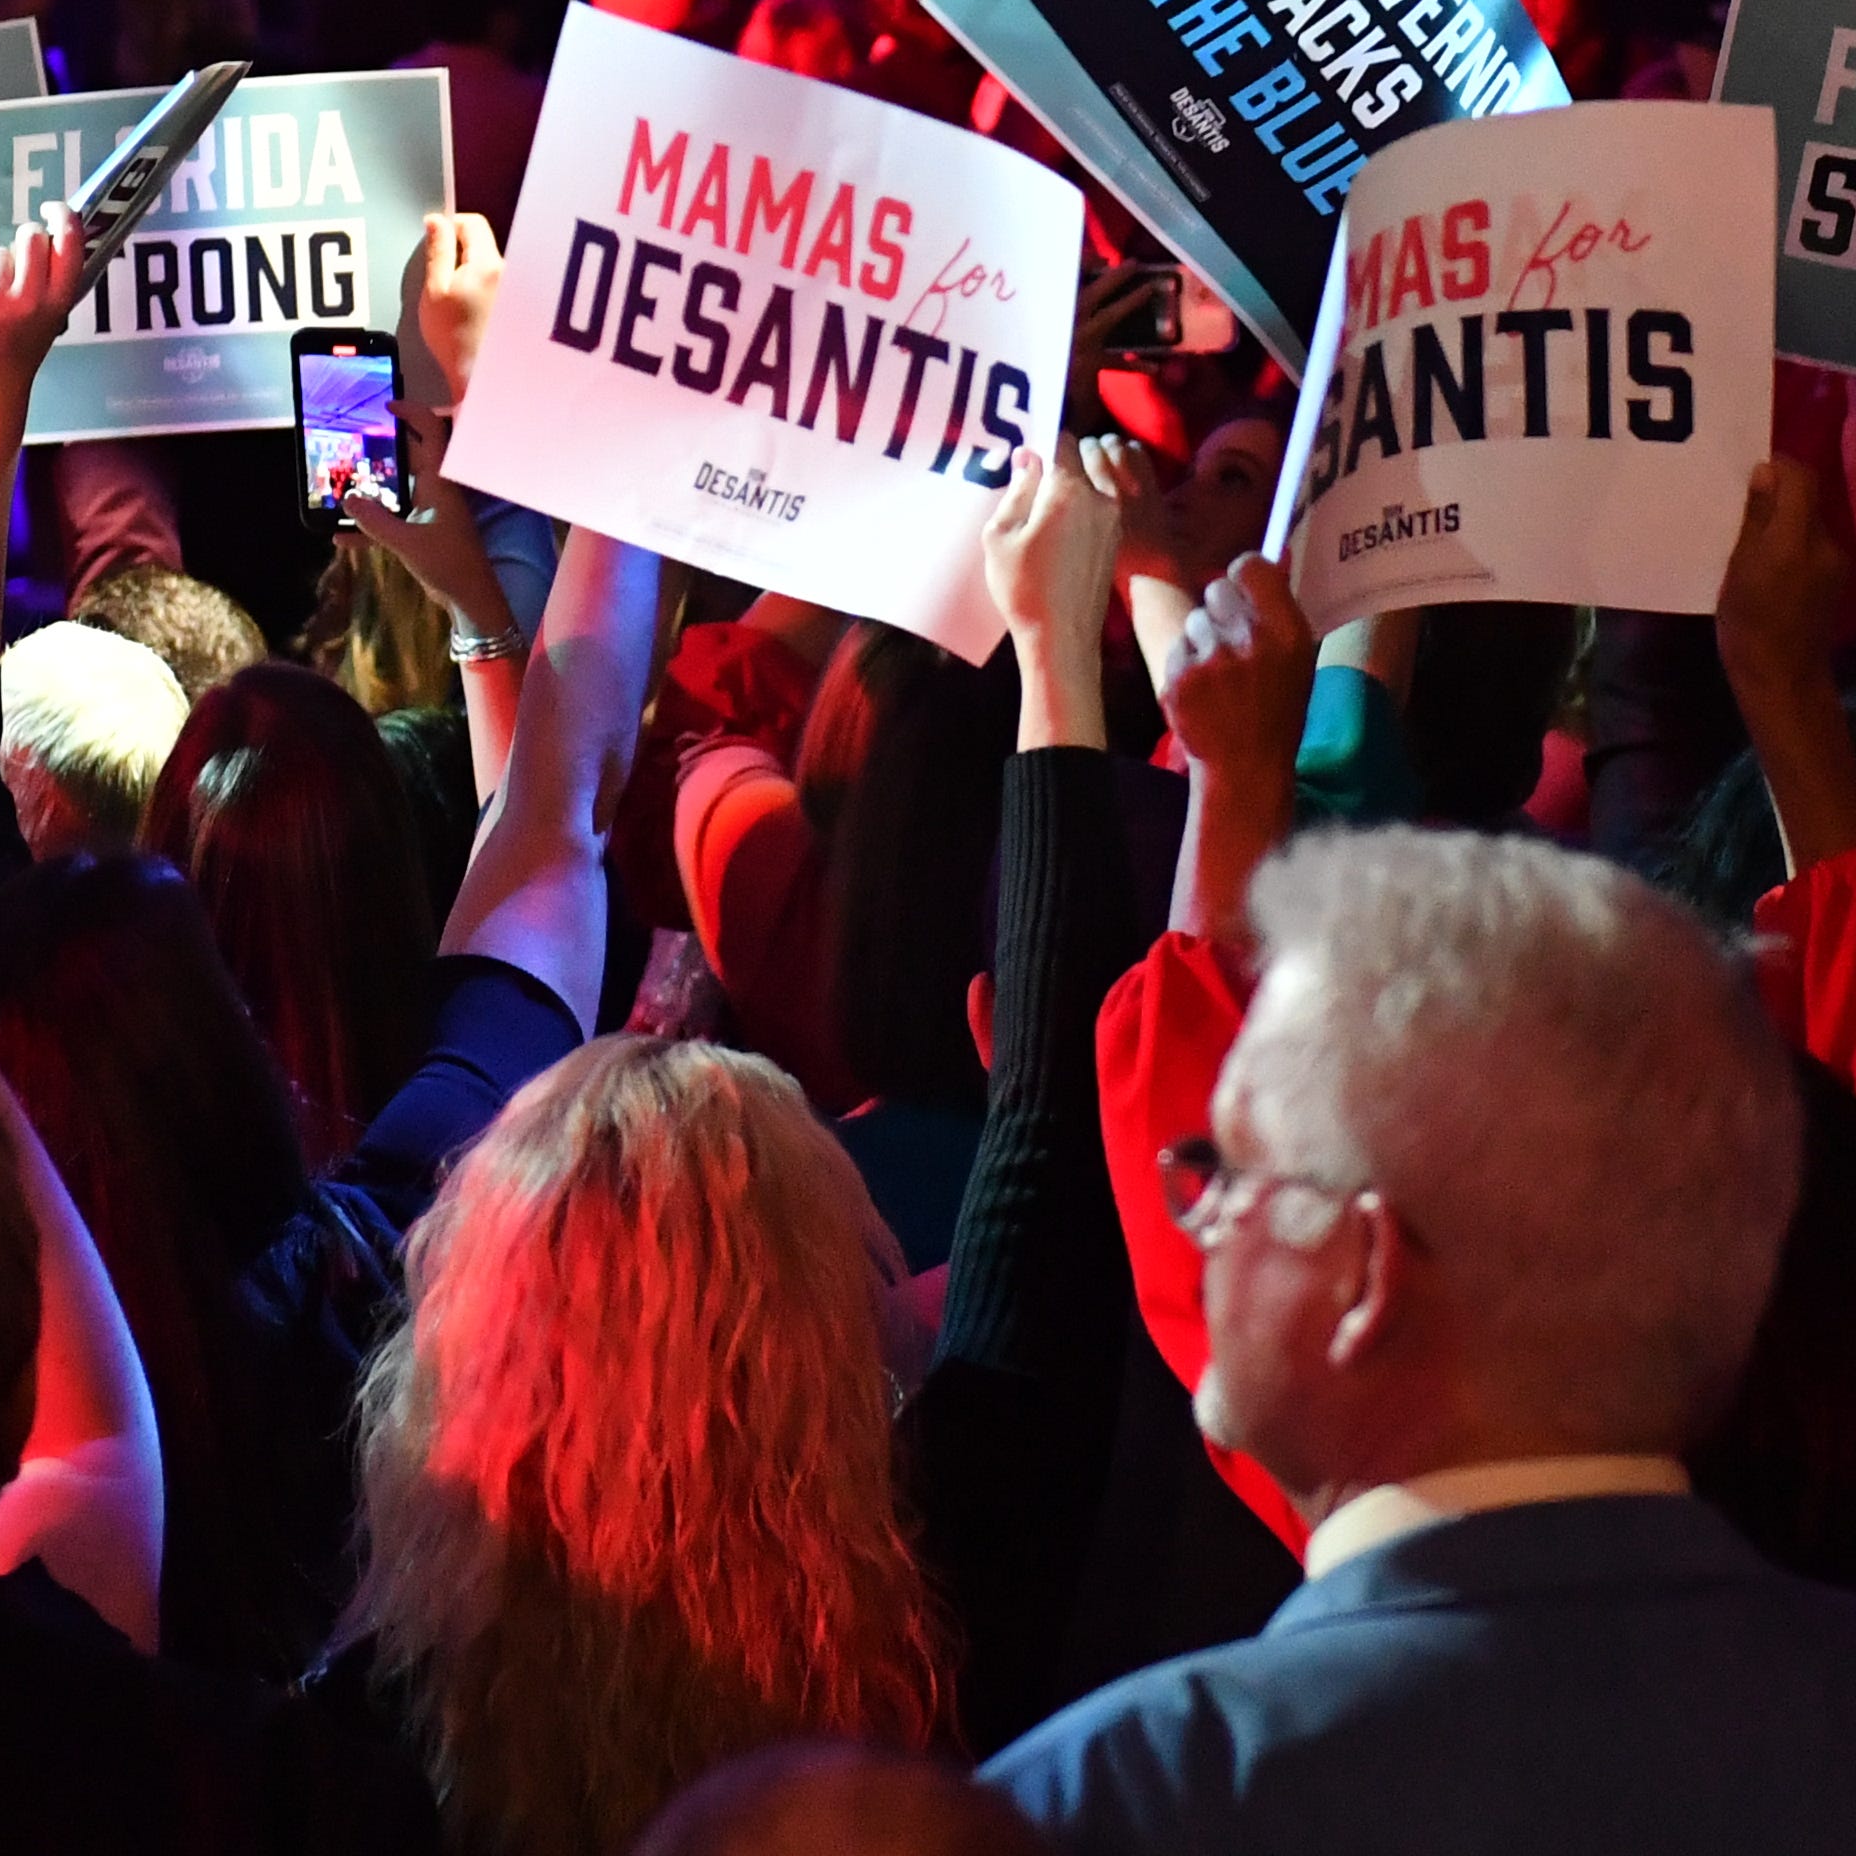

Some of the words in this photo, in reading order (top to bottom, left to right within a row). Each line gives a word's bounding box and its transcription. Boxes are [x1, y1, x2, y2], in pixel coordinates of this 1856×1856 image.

[1169, 86, 1231, 154] DESANTIS
[1229, 59, 1370, 216] BLUE
[616, 116, 913, 301] MAMAS
[899, 237, 1017, 354] for
[1344, 198, 1492, 346] MAS
[1510, 200, 1652, 337] for
[549, 216, 1033, 490] DESANTIS
[1309, 307, 1695, 502] SANTIS
[693, 460, 806, 522] DESANTIS
[1339, 502, 1461, 563] DESANTIS
